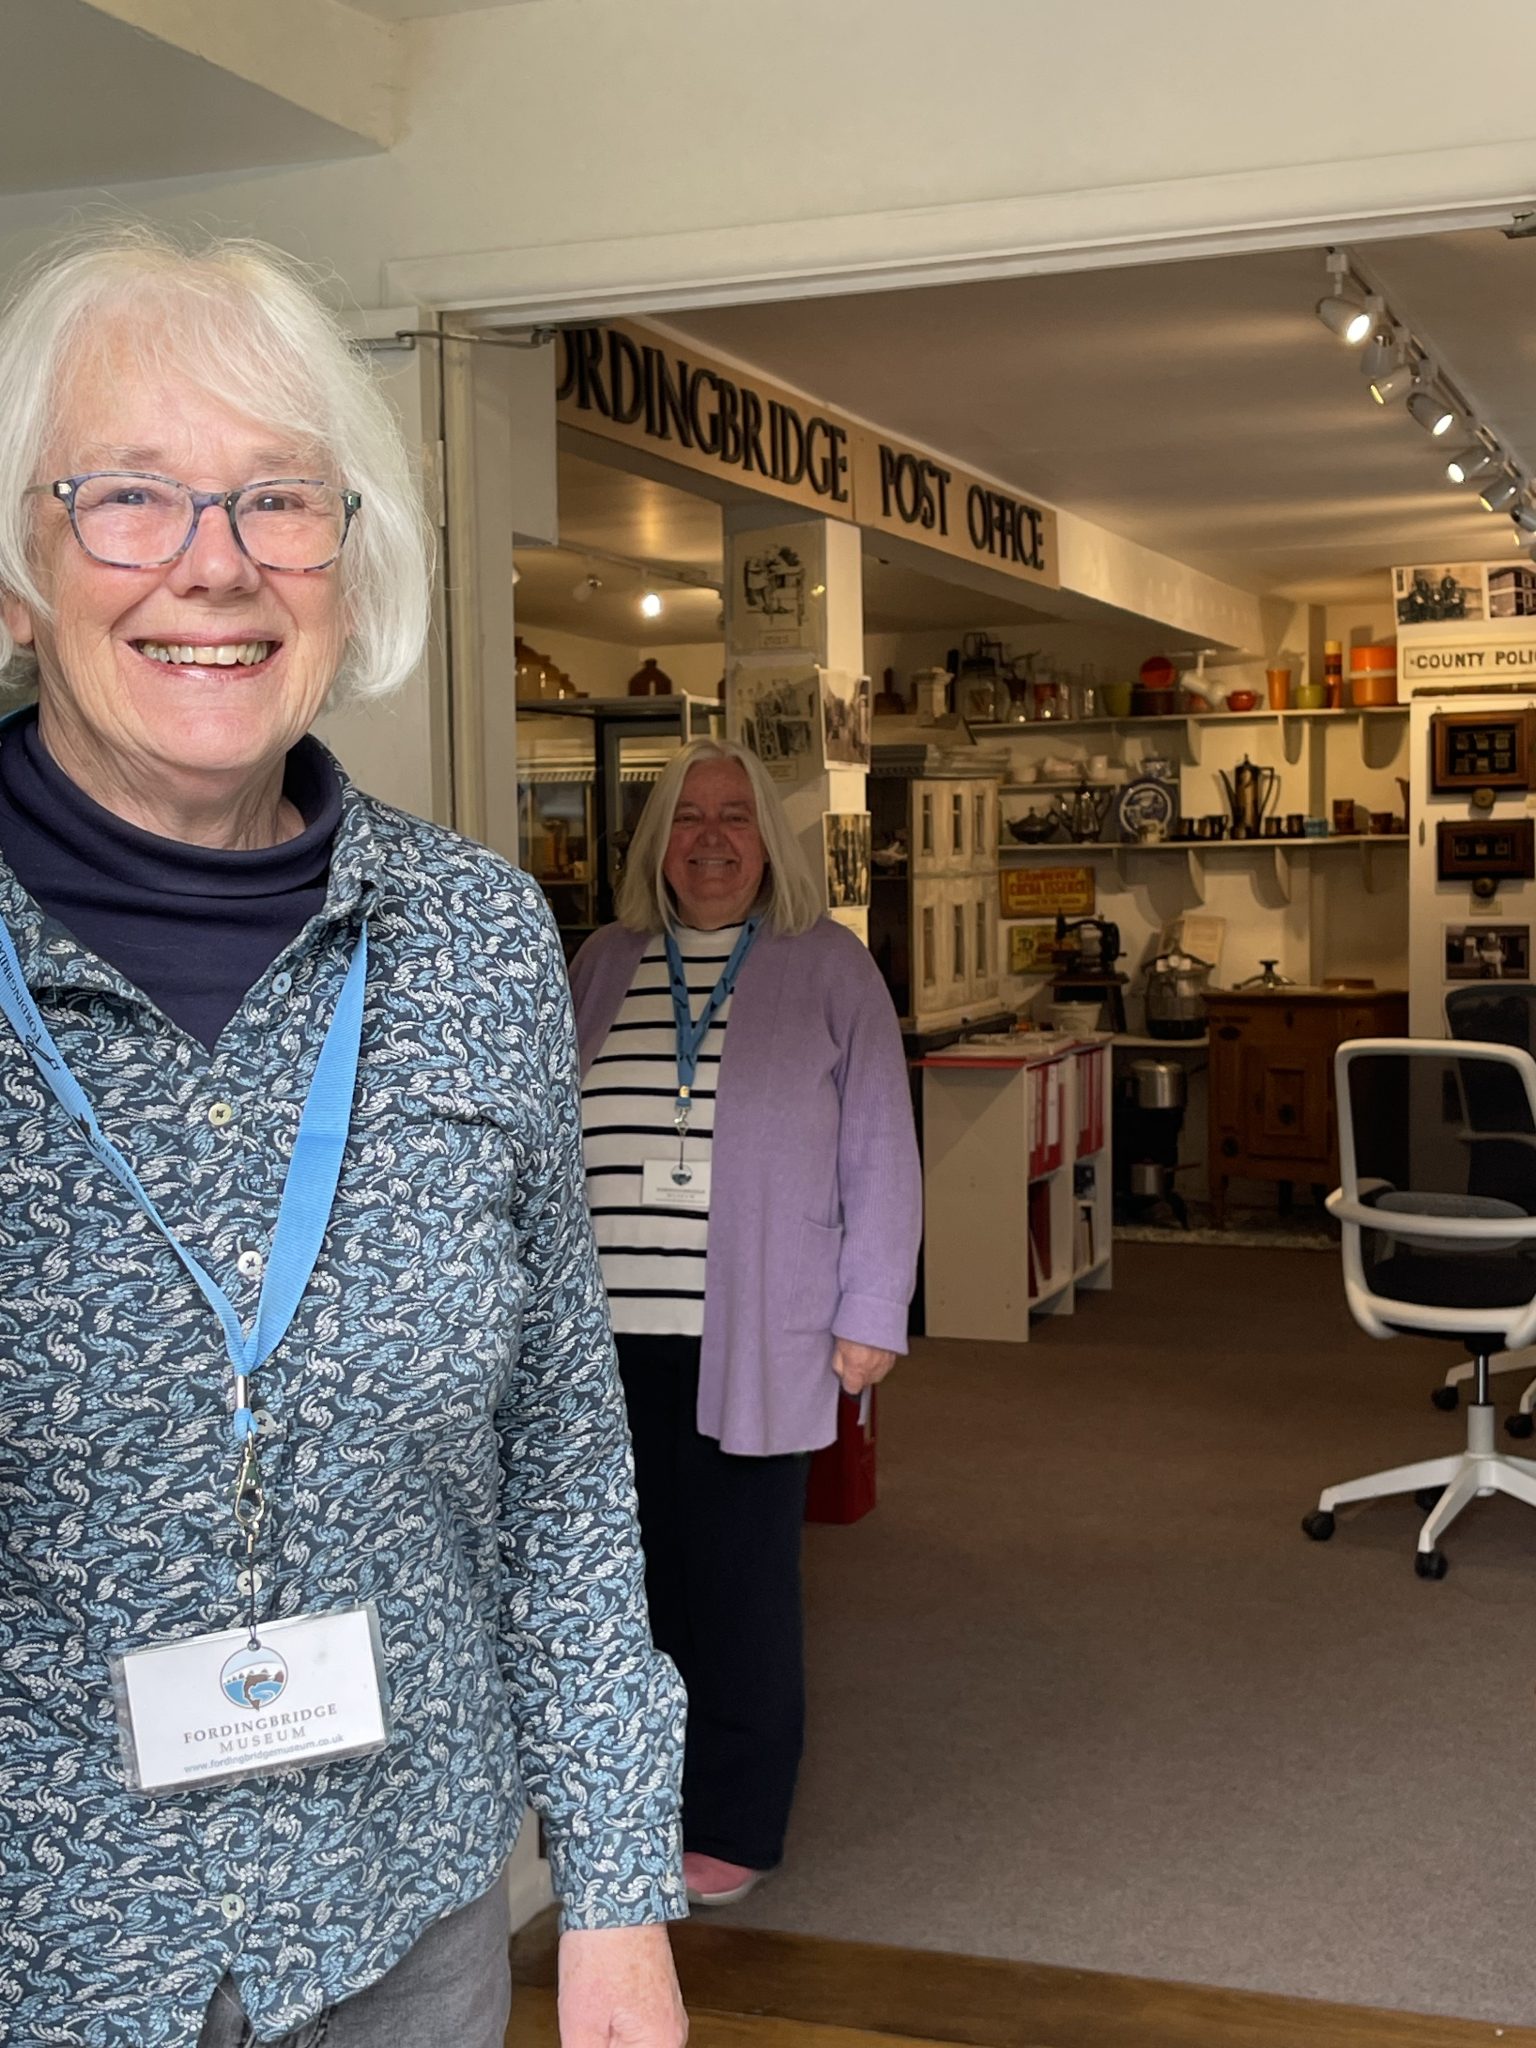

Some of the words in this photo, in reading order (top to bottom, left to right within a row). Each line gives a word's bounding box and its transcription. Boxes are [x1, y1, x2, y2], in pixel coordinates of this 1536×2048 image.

[878, 444, 951, 536] POST
[966, 484, 1045, 571] OFFICE
[1416, 652, 1485, 669] COUNTY
[1495, 649, 1536, 665] POLI
[183, 1703, 338, 1744] FORDINGBRIDGE
[218, 1725, 307, 1754] MUSEUM
[184, 1733, 345, 1773] www.fordingbridgemuseum.co.uk
